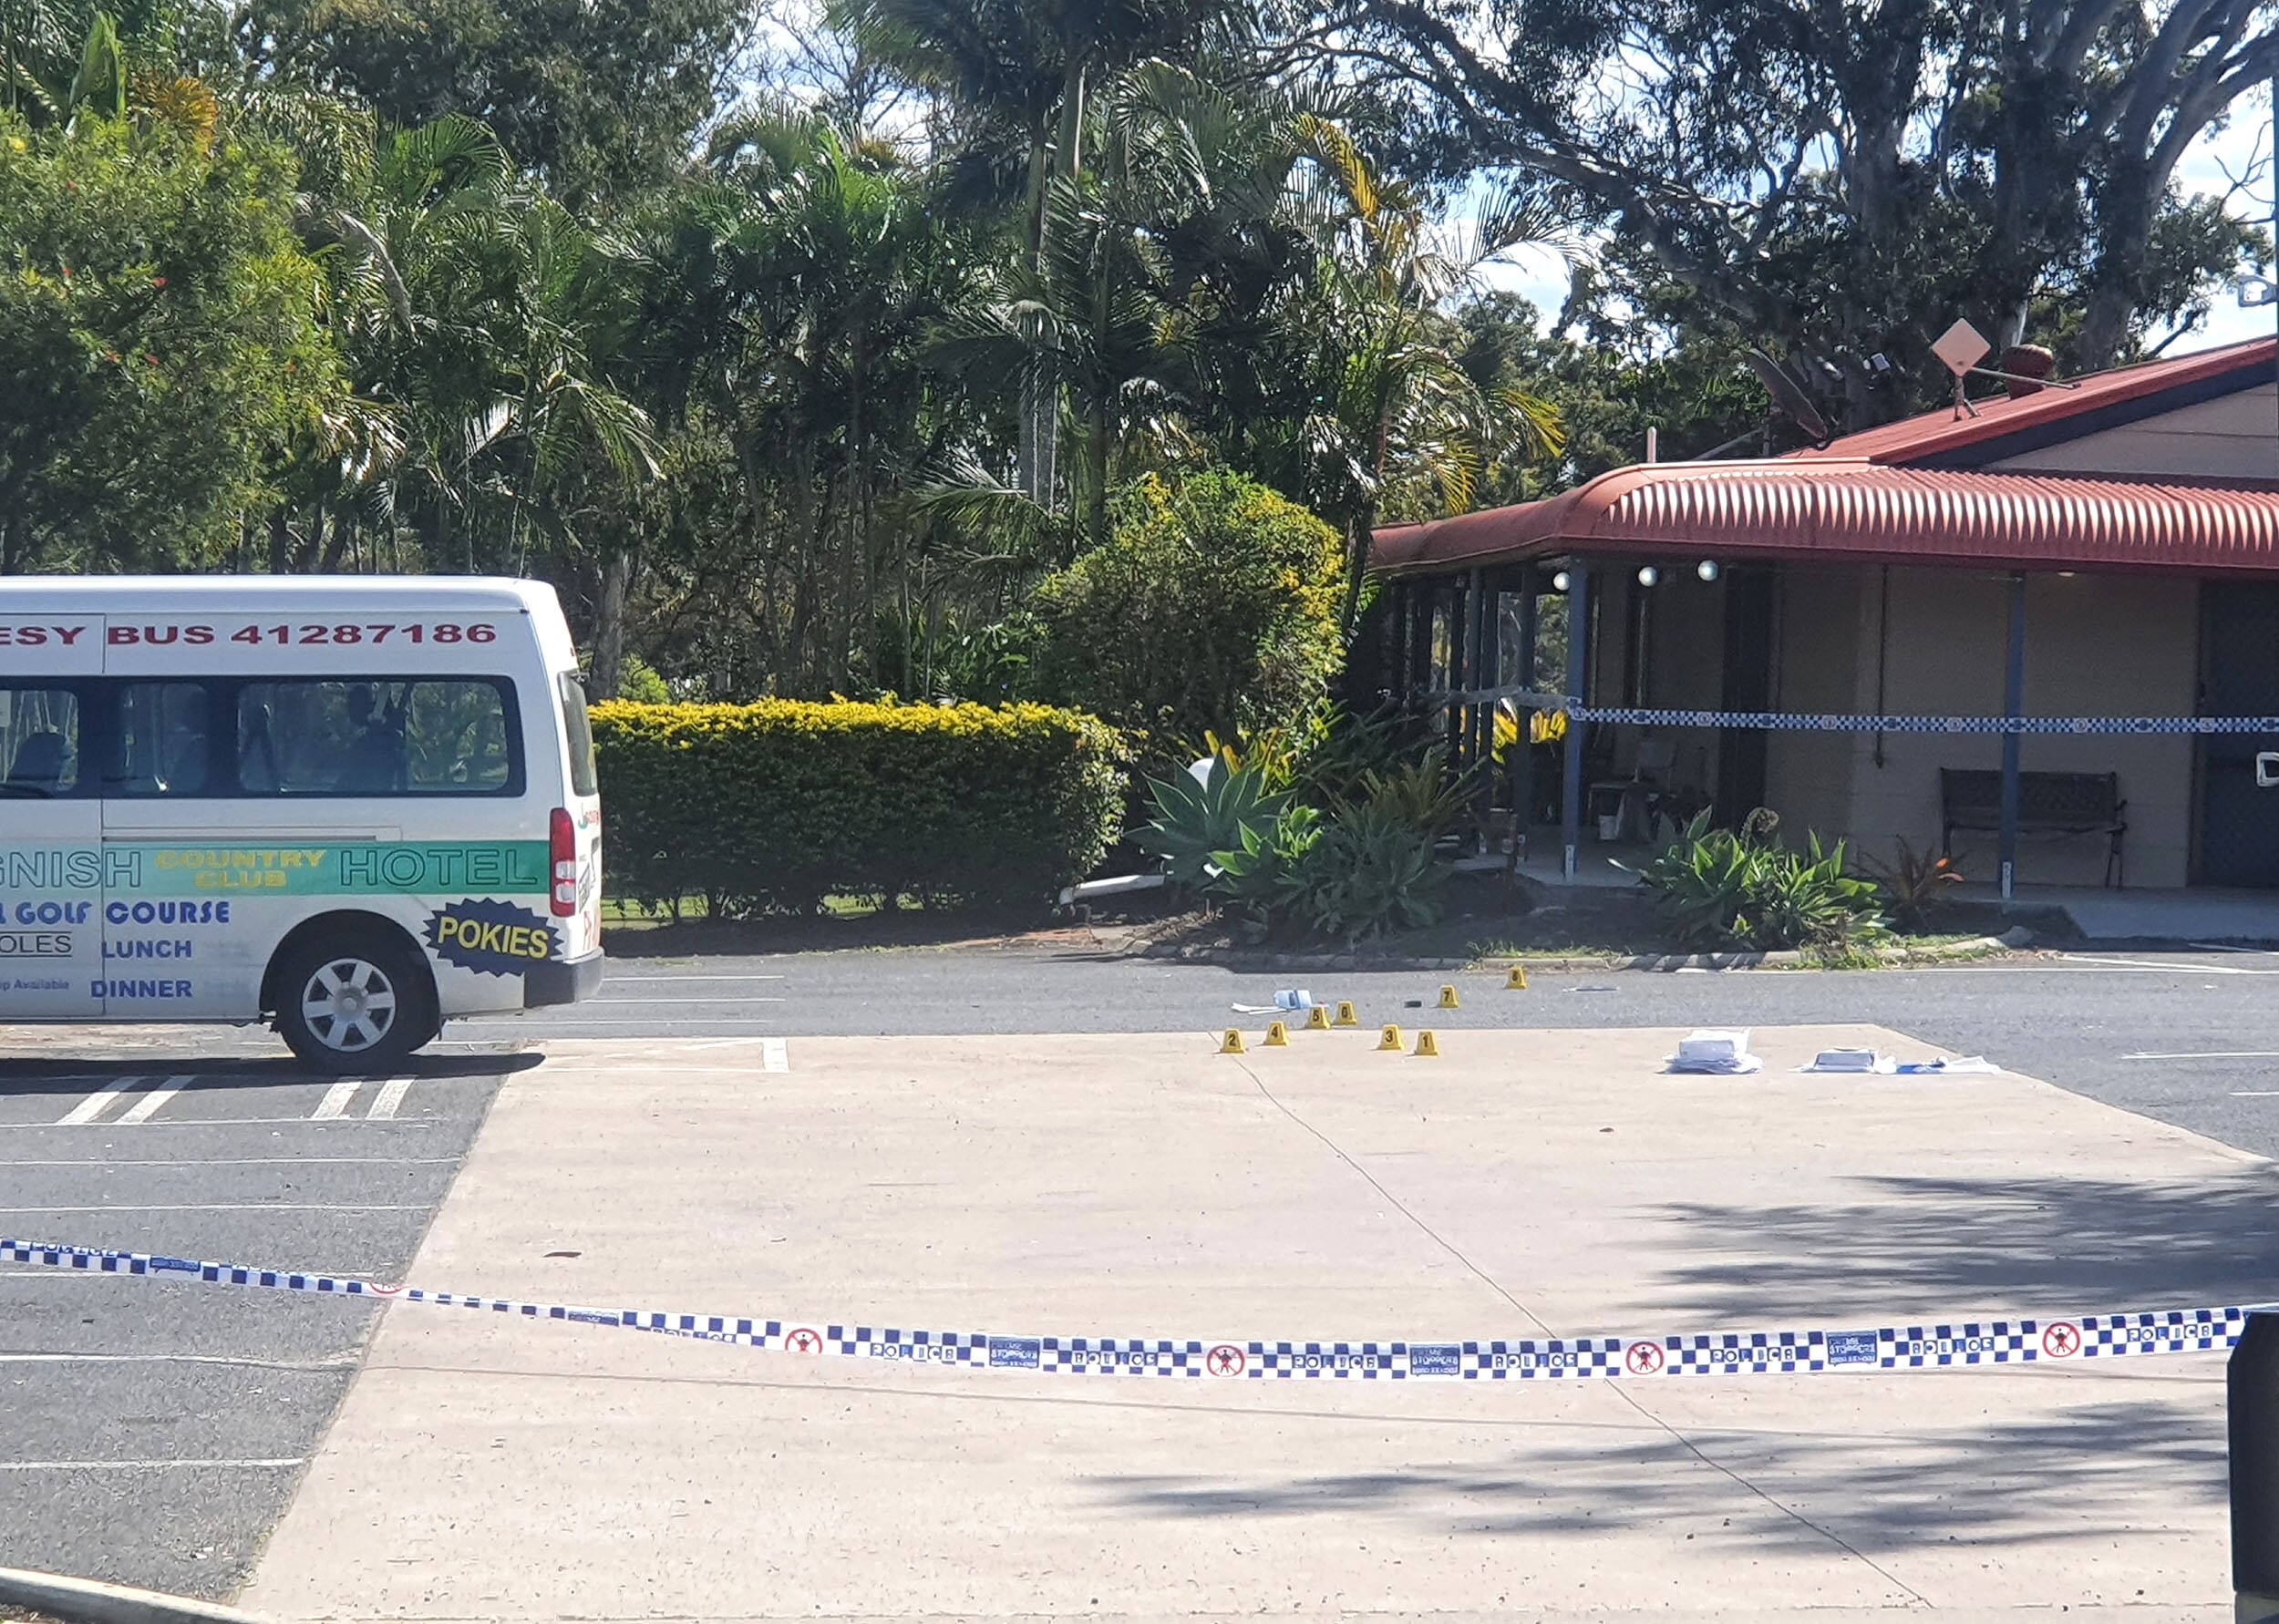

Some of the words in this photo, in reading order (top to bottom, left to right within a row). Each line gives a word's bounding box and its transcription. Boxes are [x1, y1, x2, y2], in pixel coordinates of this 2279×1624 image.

[107, 625, 216, 645] BUS
[230, 623, 497, 644] 41287186
[0, 850, 142, 889] NISH
[154, 849, 327, 870] COUNTRY
[338, 848, 539, 887] HOTEL
[194, 870, 288, 890] CLUB
[15, 900, 93, 925] GOLF
[105, 900, 231, 925] COURSE
[438, 916, 549, 960] POKIES
[100, 940, 193, 959] LUNCH
[90, 980, 193, 998] DINNER
[2129, 1324, 2210, 1342] POLICE
